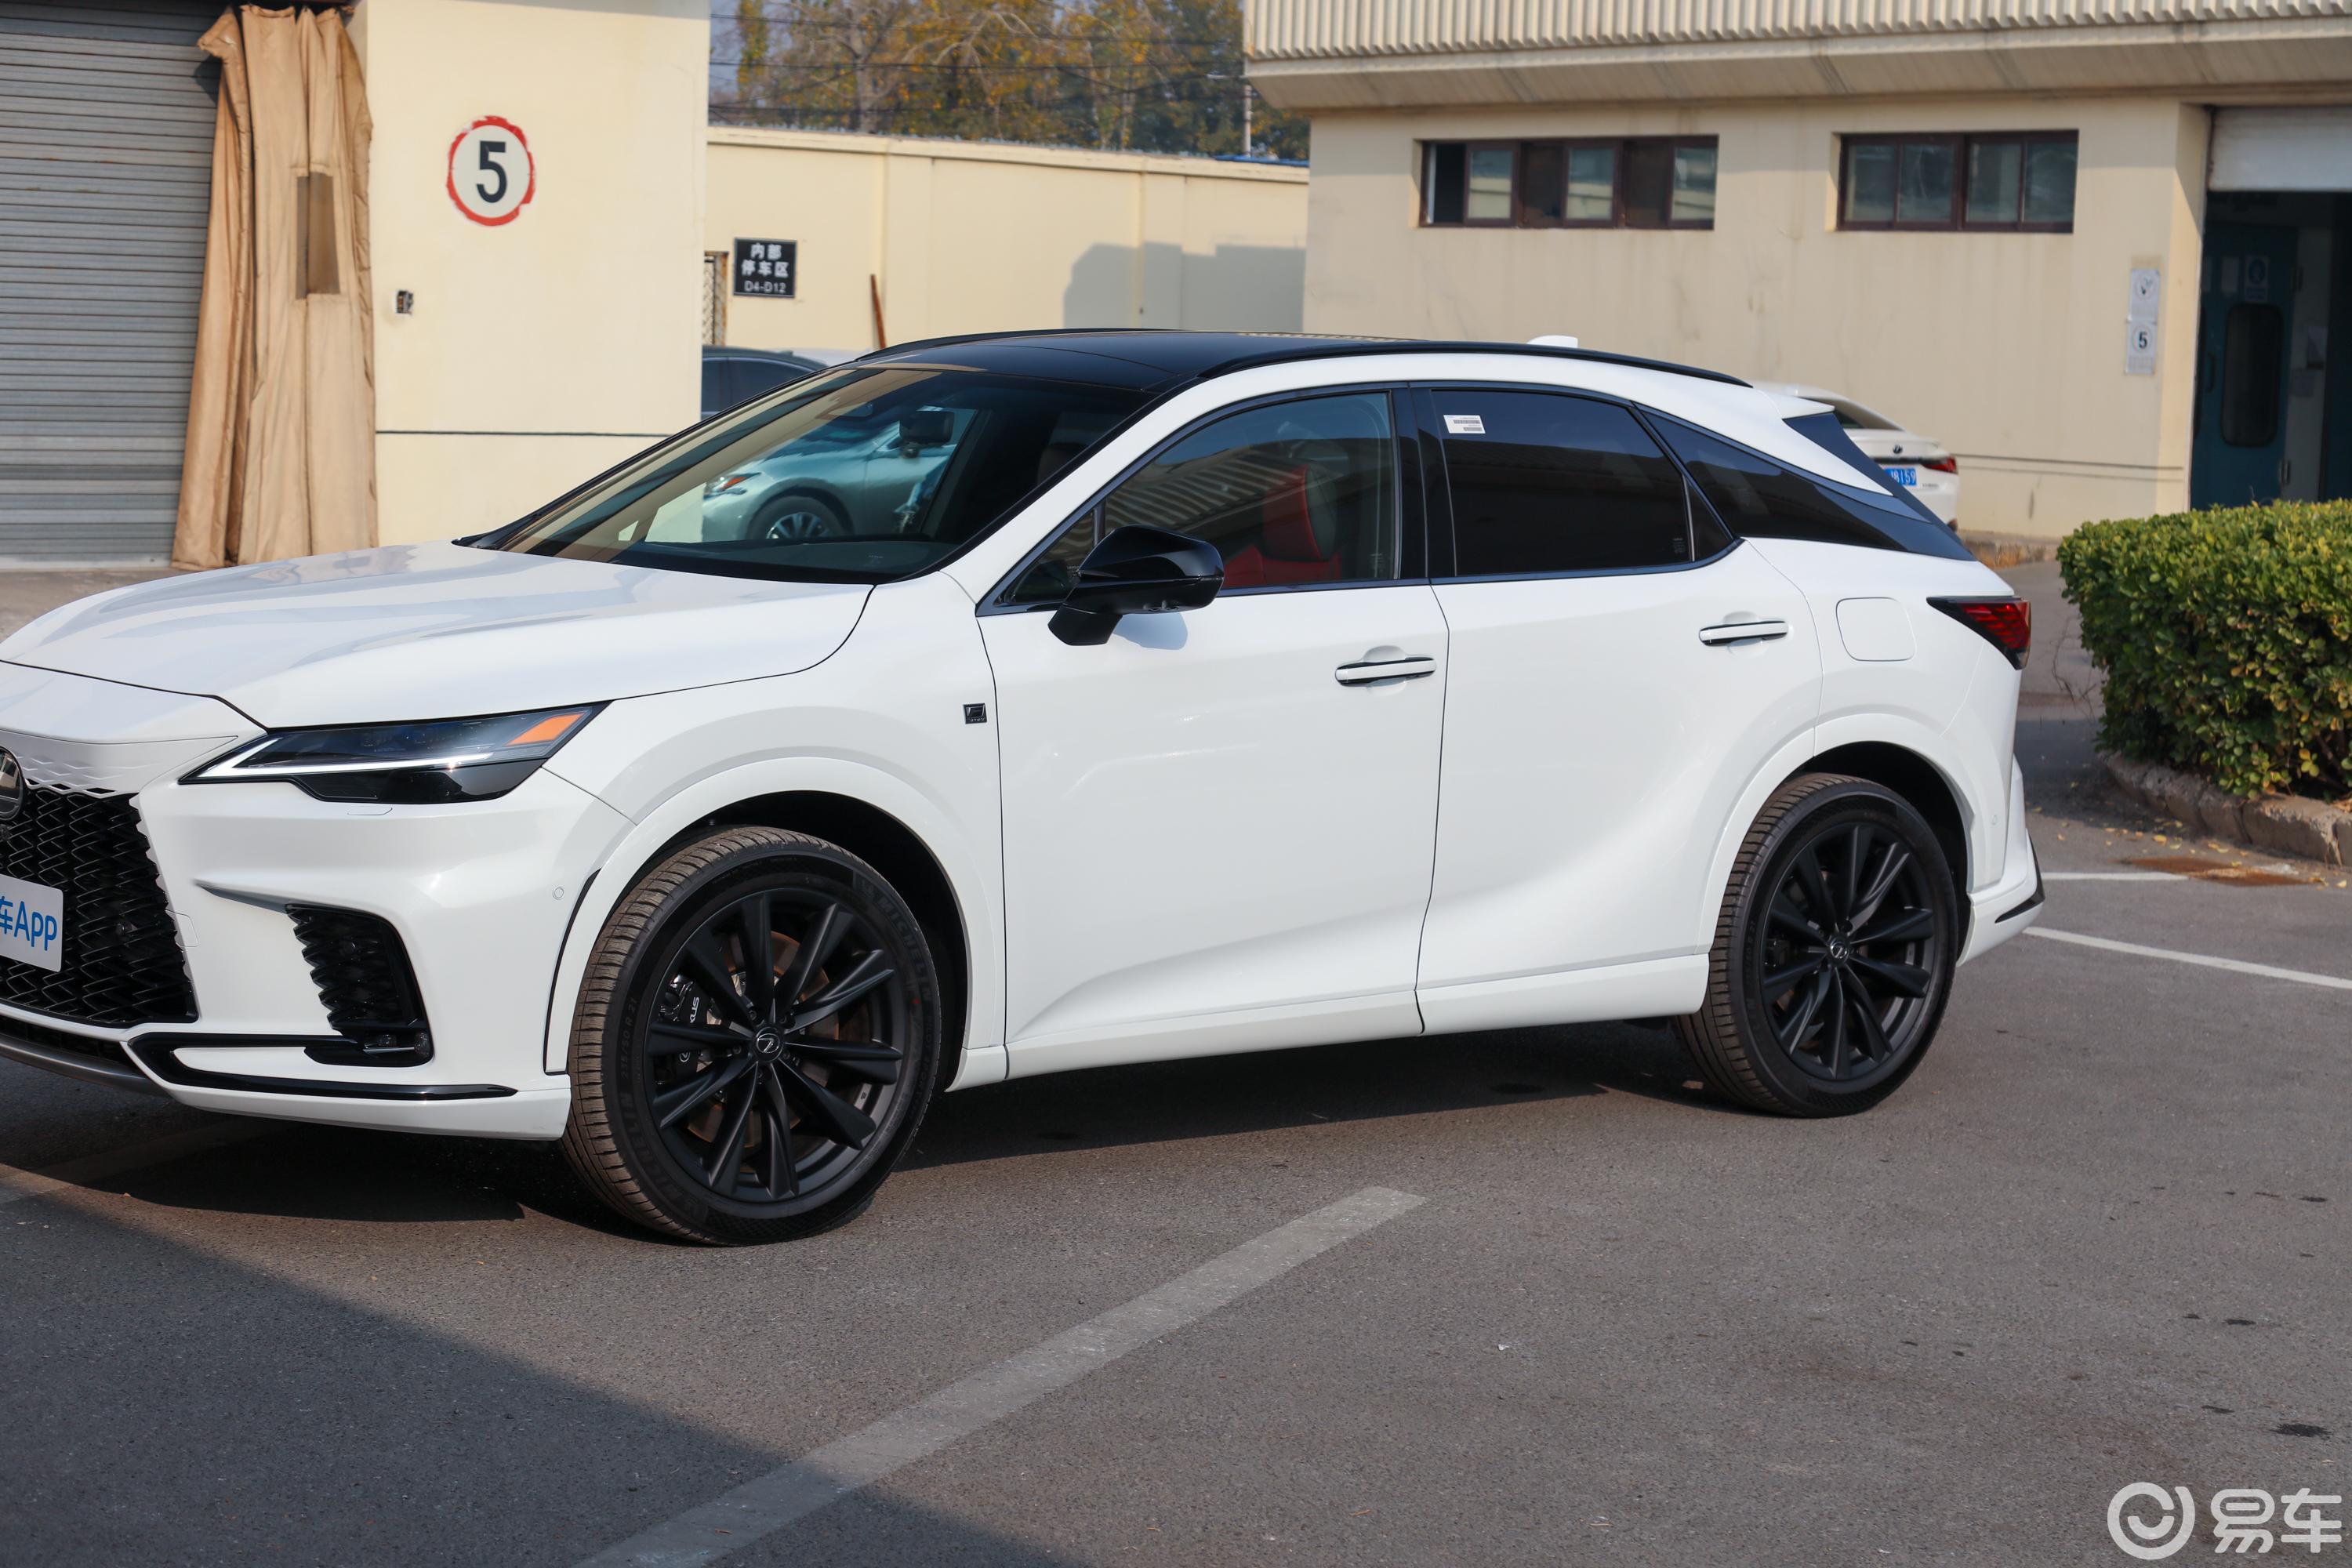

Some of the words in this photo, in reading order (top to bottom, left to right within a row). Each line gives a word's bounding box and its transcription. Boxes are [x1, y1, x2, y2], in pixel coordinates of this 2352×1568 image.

[477, 140, 507, 203] 5
[750, 242, 782, 260] 内部
[741, 259, 789, 278] 停车区
[2138, 331, 2147, 350] 5
